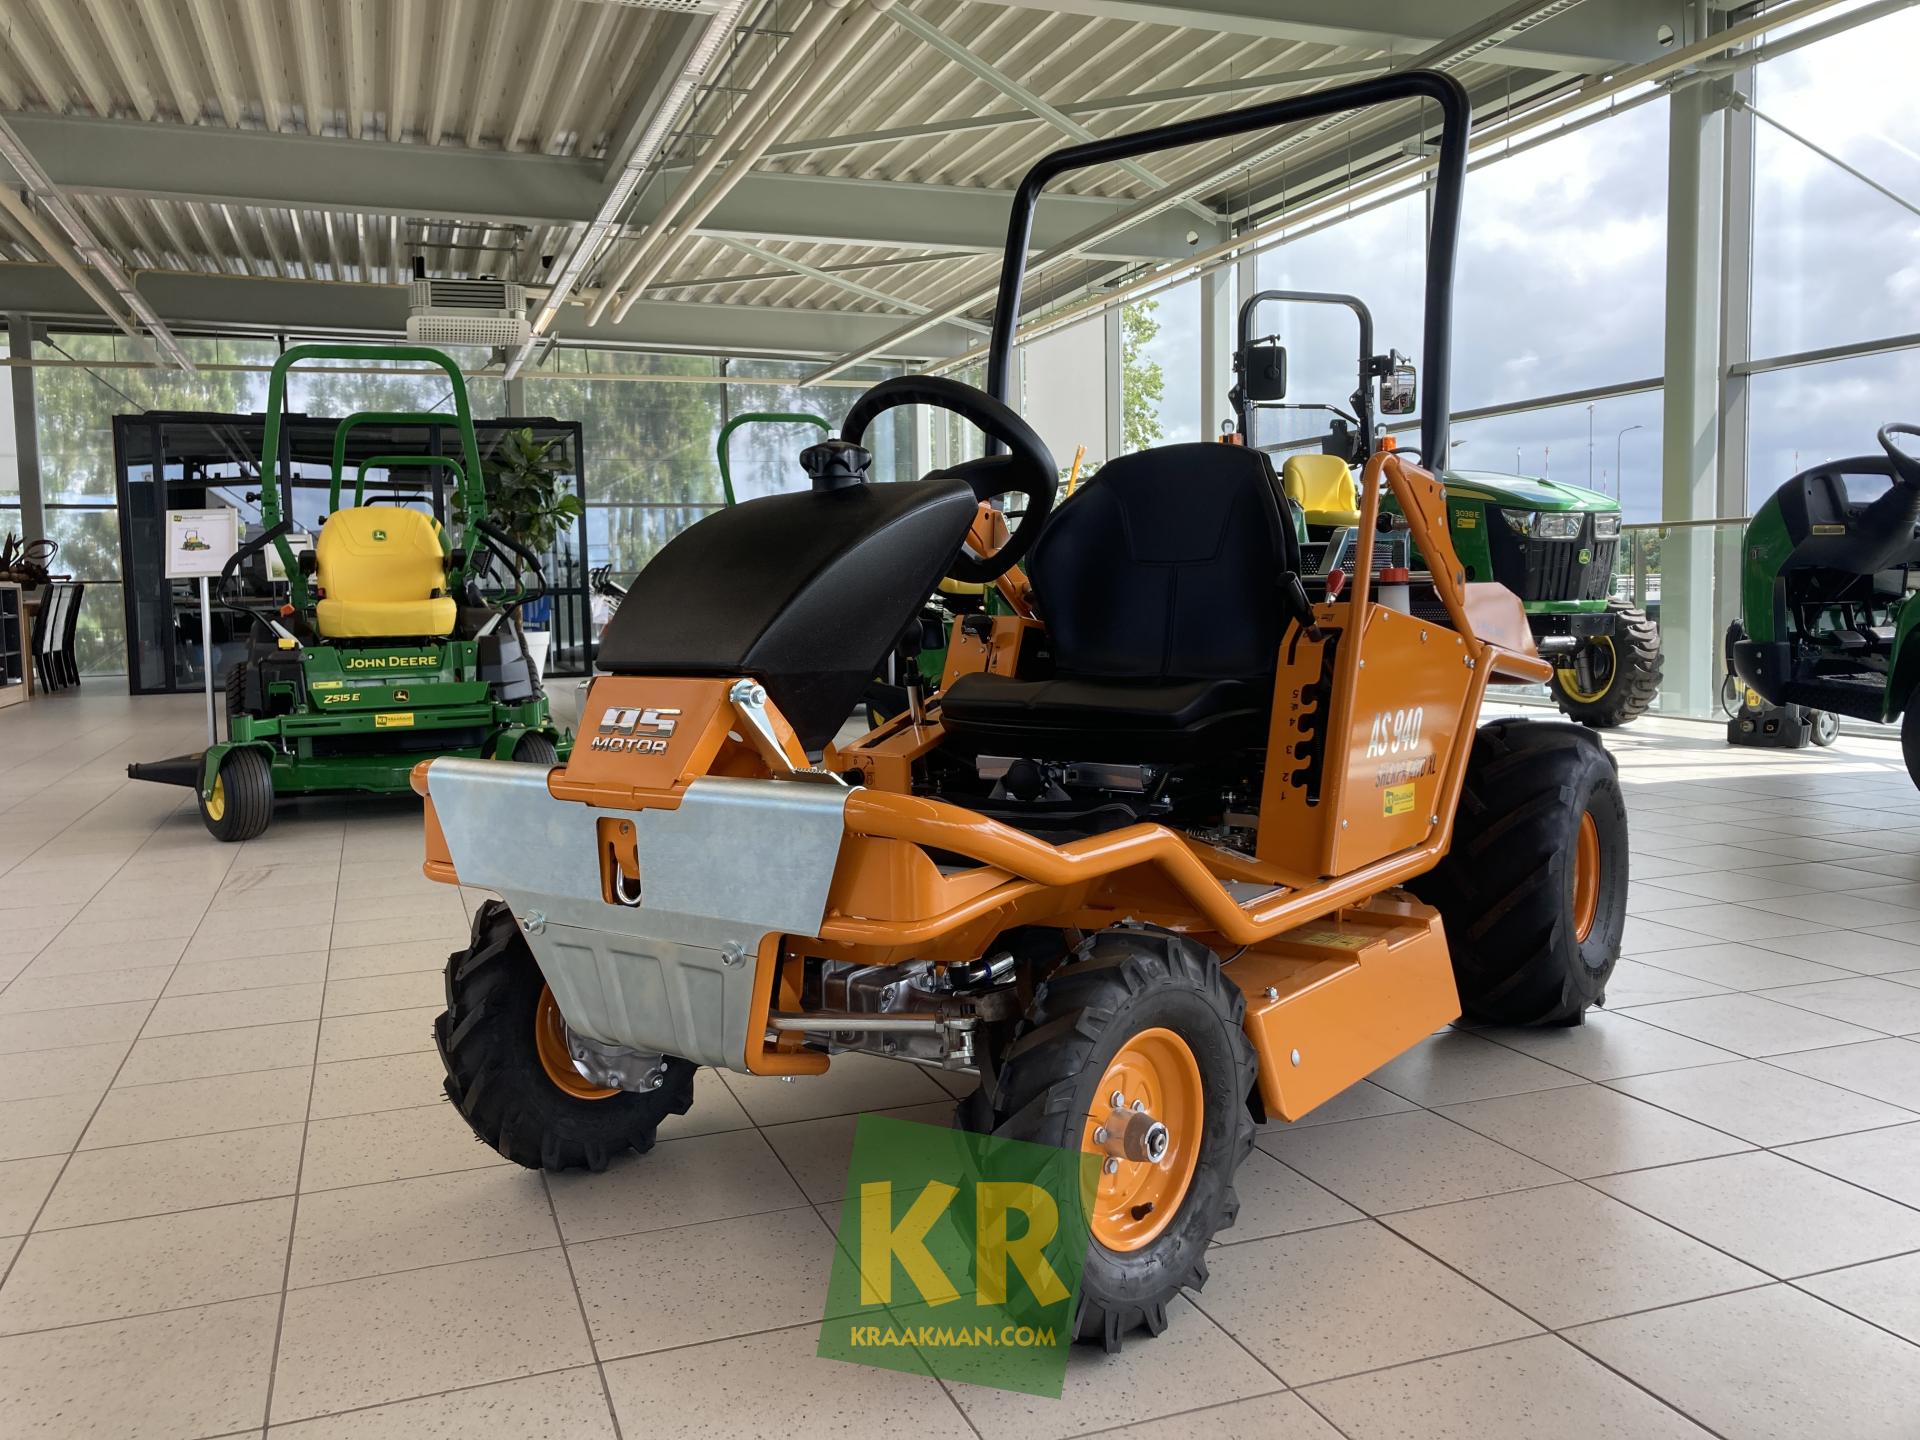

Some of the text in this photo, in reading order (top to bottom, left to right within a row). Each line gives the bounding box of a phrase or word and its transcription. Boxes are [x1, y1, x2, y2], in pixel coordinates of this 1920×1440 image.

[1475, 511, 1481, 519] E
[346, 656, 437, 669] JOHN DEERE
[323, 693, 361, 704] Z515 E
[1292, 689, 1299, 698] 5
[598, 706, 683, 738] AS
[1289, 718, 1296, 727] 4
[1366, 706, 1424, 759] AS 940
[591, 736, 669, 755] MOTOR
[1286, 745, 1292, 754] 3
[1281, 772, 1288, 782] 2
[1280, 791, 1286, 801] 1
